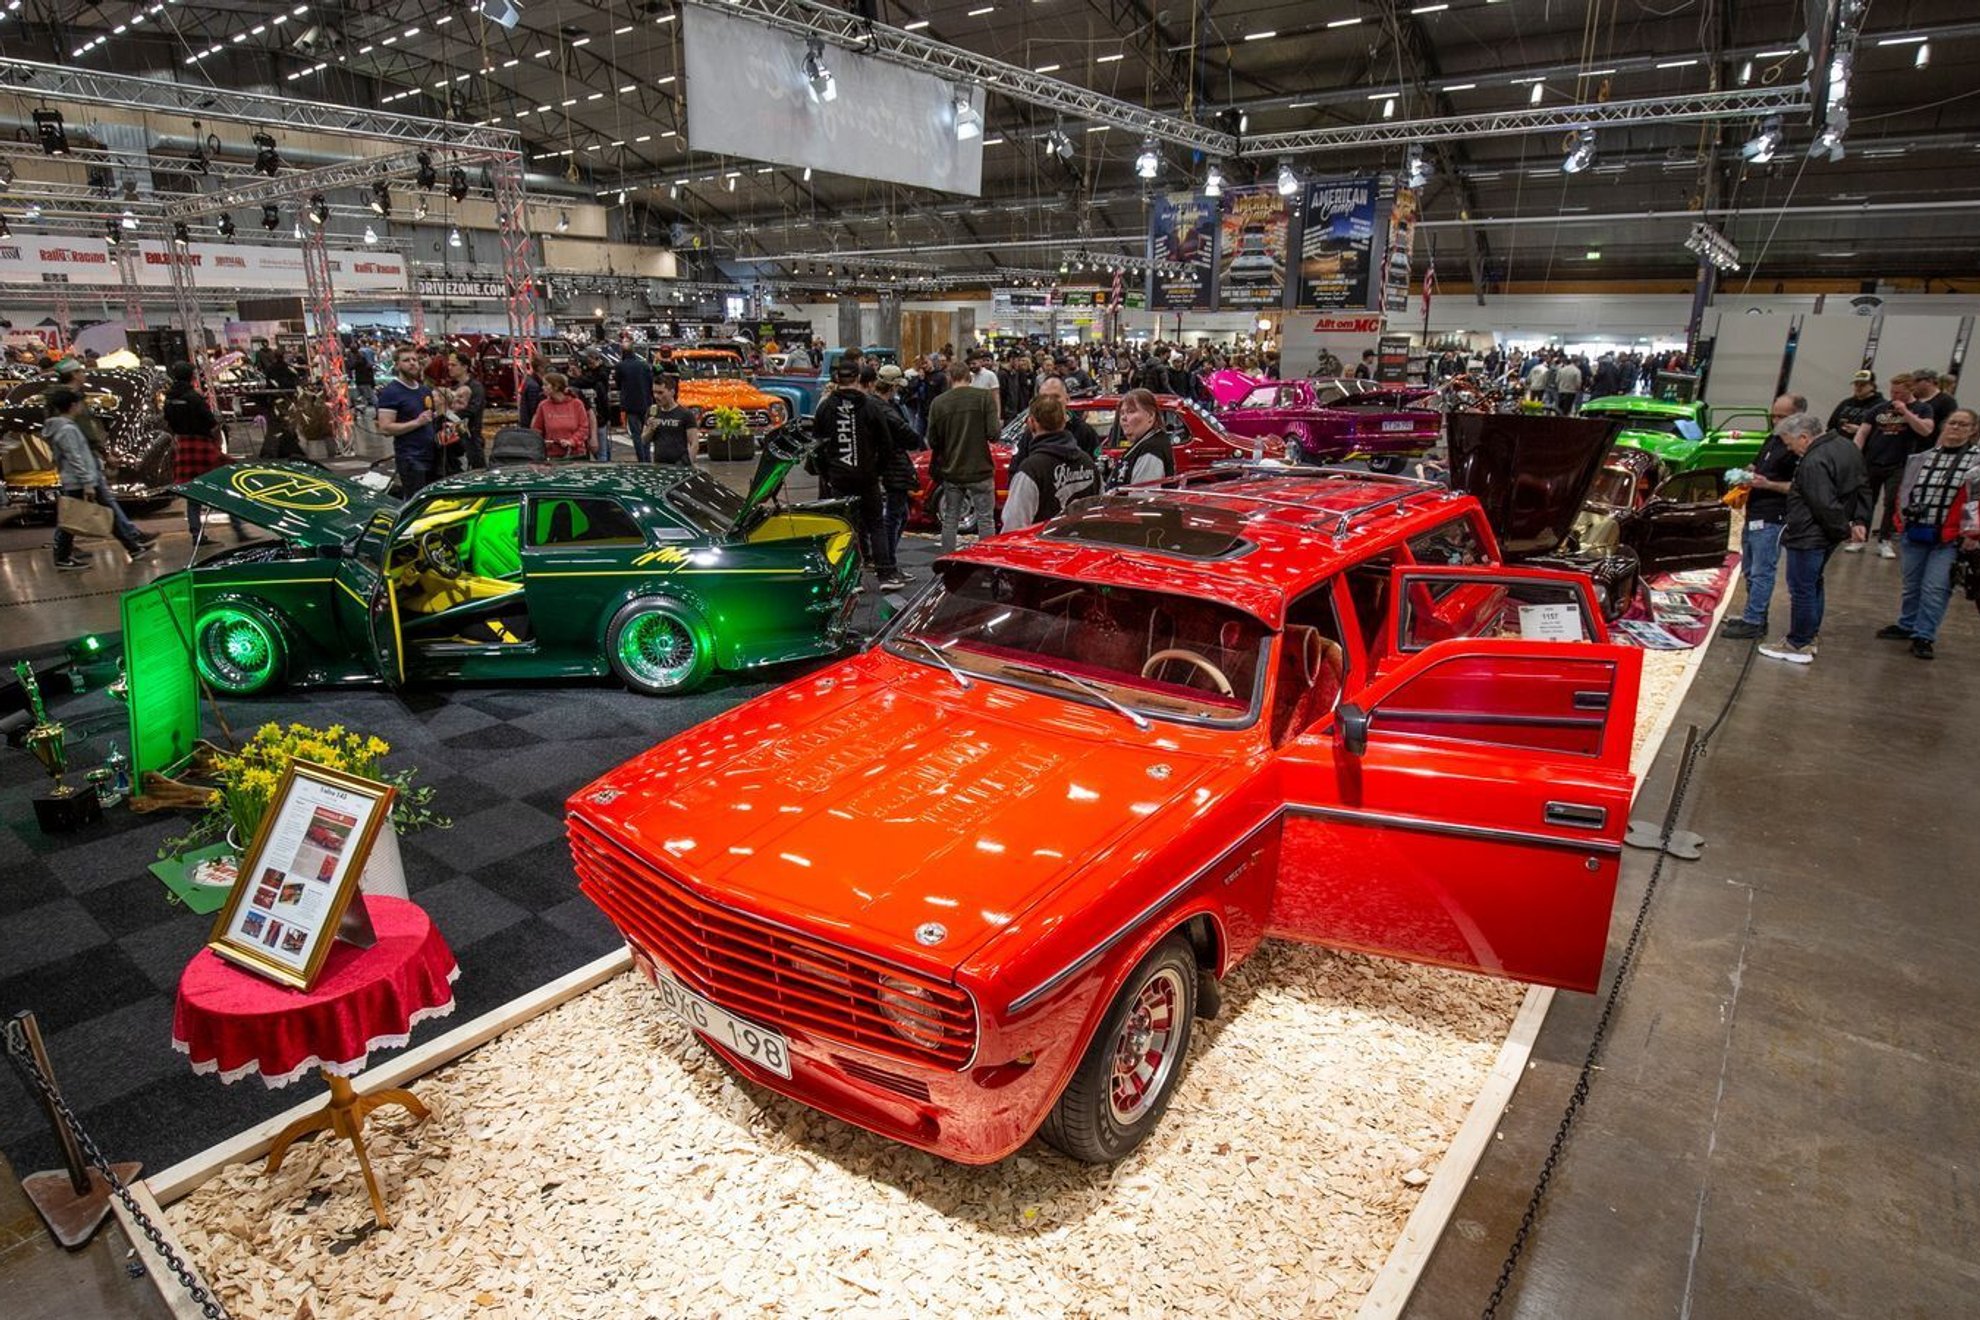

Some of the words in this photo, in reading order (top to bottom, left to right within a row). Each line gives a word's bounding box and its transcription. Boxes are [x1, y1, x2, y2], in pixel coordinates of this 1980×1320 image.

[1311, 188, 1369, 209] AMERICAN
[1320, 201, 1356, 221] Camp
[1316, 319, 1335, 329] Allt
[1337, 321, 1354, 329] om
[1354, 319, 1379, 332] MC
[837, 399, 854, 466] ALPHA
[728, 1020, 783, 1069] 198
